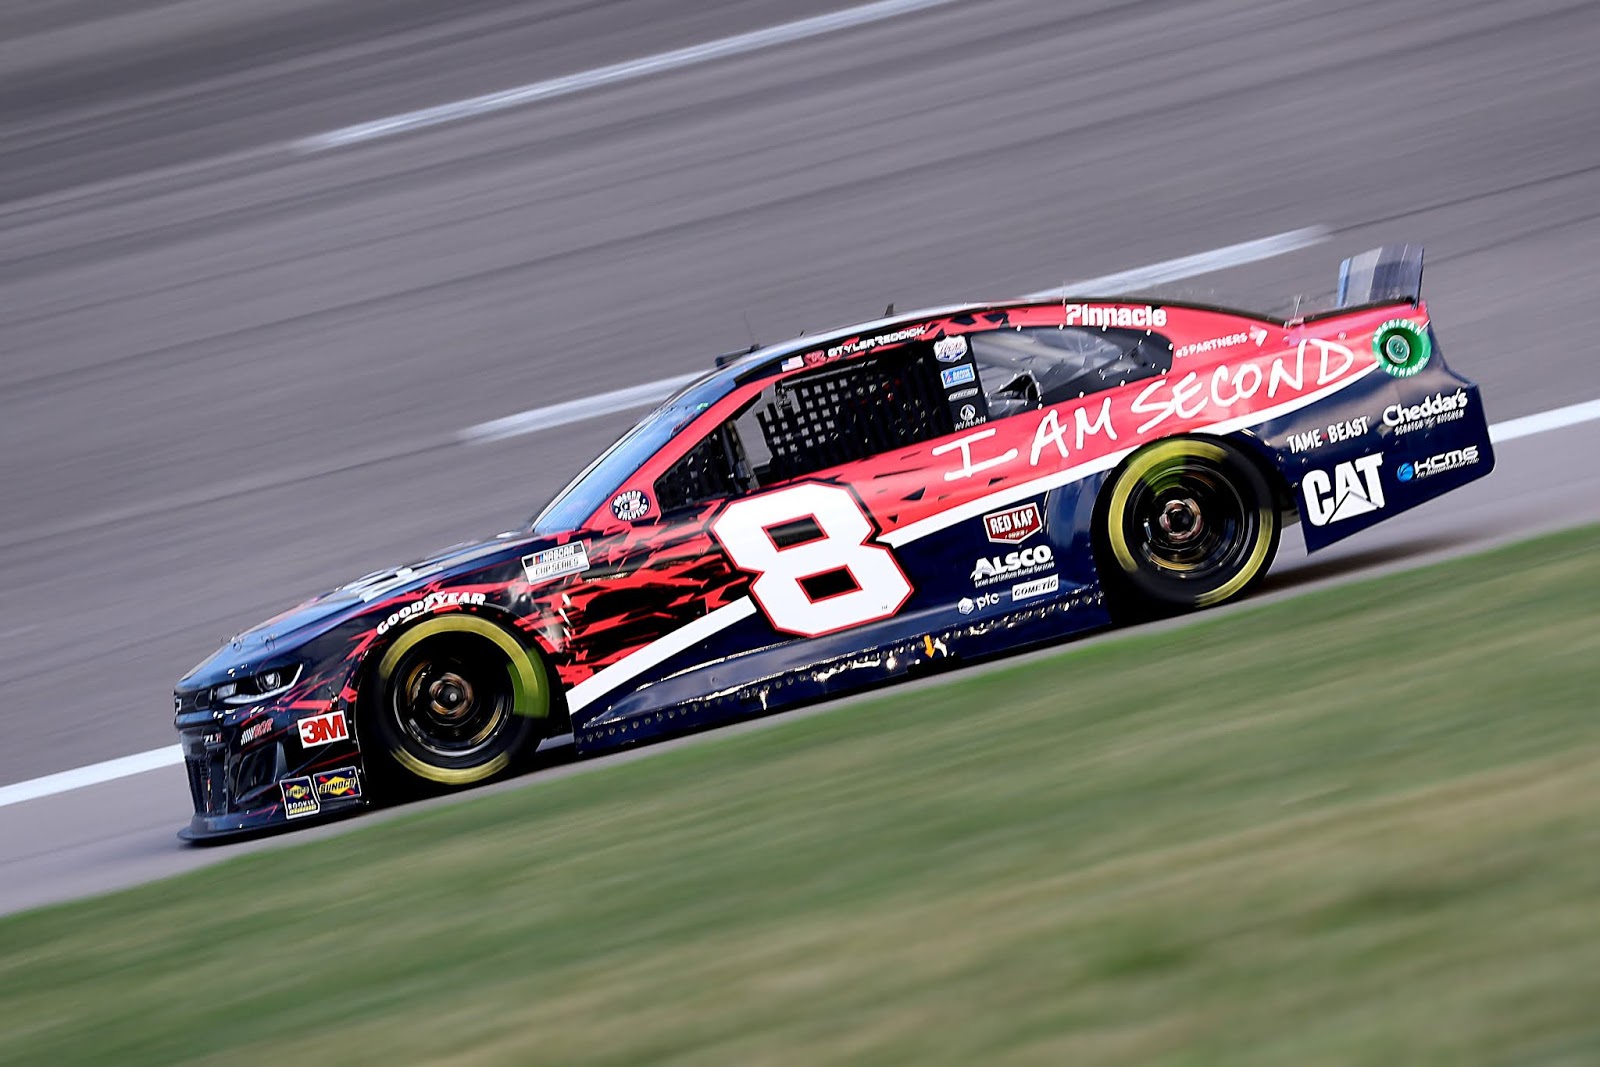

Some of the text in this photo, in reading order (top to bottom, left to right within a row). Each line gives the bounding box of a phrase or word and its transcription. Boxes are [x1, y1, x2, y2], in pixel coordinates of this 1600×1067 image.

[1066, 304, 1167, 327] Pinnacle
[932, 339, 1355, 482] I AM SECOND
[1382, 387, 1468, 427] Cheddar's
[1287, 416, 1369, 454] TAME BEAST
[1302, 452, 1385, 526] CAT
[618, 503, 648, 521] SALUTES
[989, 514, 1012, 535] RED
[1012, 508, 1034, 530] KAP
[543, 545, 575, 562] NASCAR
[709, 479, 915, 639] 8
[970, 544, 1053, 582] ALSCO
[377, 590, 486, 635] GOODYEAR
[976, 592, 1000, 611] ptc
[301, 714, 347, 745] 3M
[319, 777, 356, 795] SUNOCO
